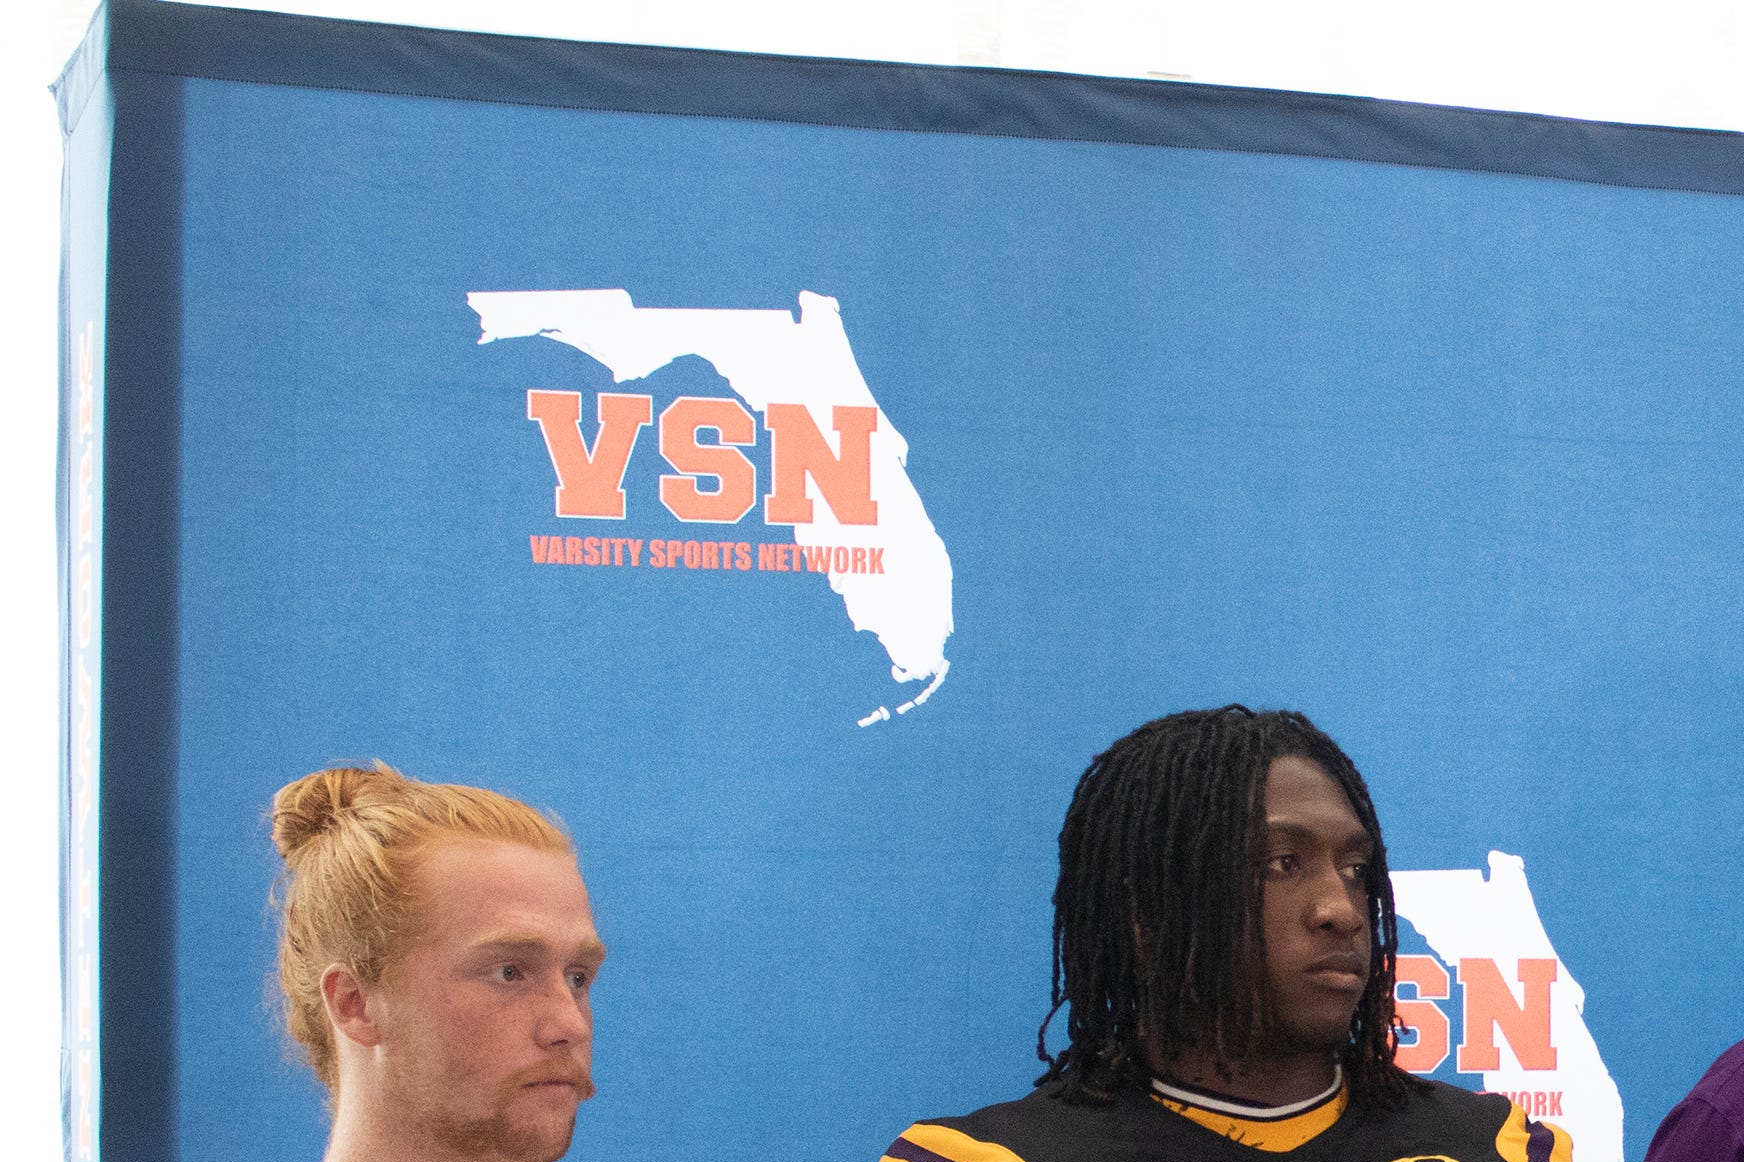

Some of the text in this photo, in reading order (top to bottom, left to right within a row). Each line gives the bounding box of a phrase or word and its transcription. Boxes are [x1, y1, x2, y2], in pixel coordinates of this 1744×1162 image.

[527, 389, 879, 526] VSN
[529, 535, 886, 575] VARSITY SPORTS NETWORK
[1387, 954, 1558, 1074] SN
